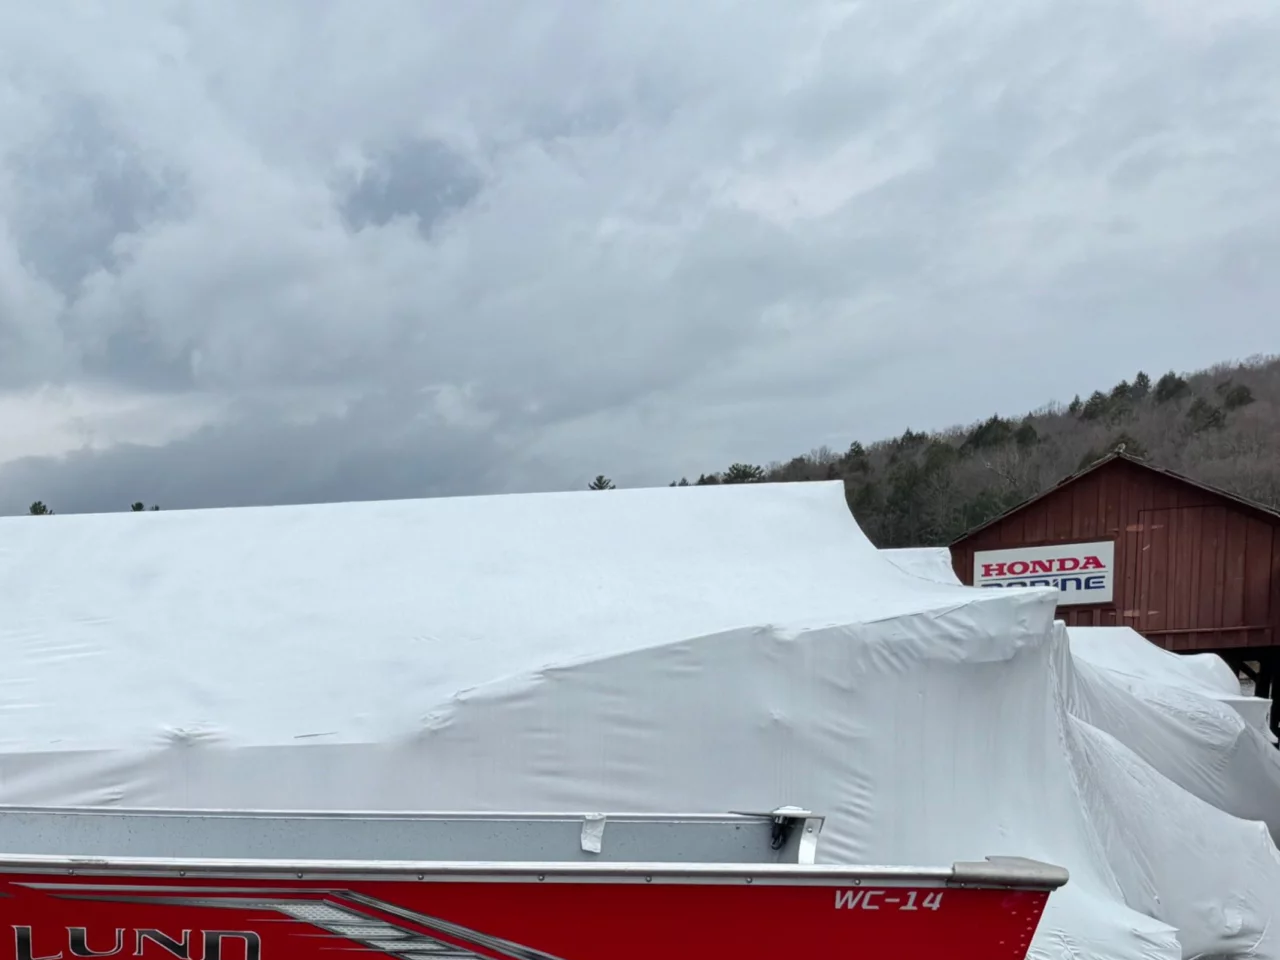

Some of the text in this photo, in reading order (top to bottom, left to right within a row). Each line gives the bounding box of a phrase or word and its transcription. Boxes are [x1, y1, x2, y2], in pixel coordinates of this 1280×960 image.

[981, 556, 1106, 577] HONDA
[981, 575, 1106, 592] INE
[835, 890, 944, 911] WC-14
